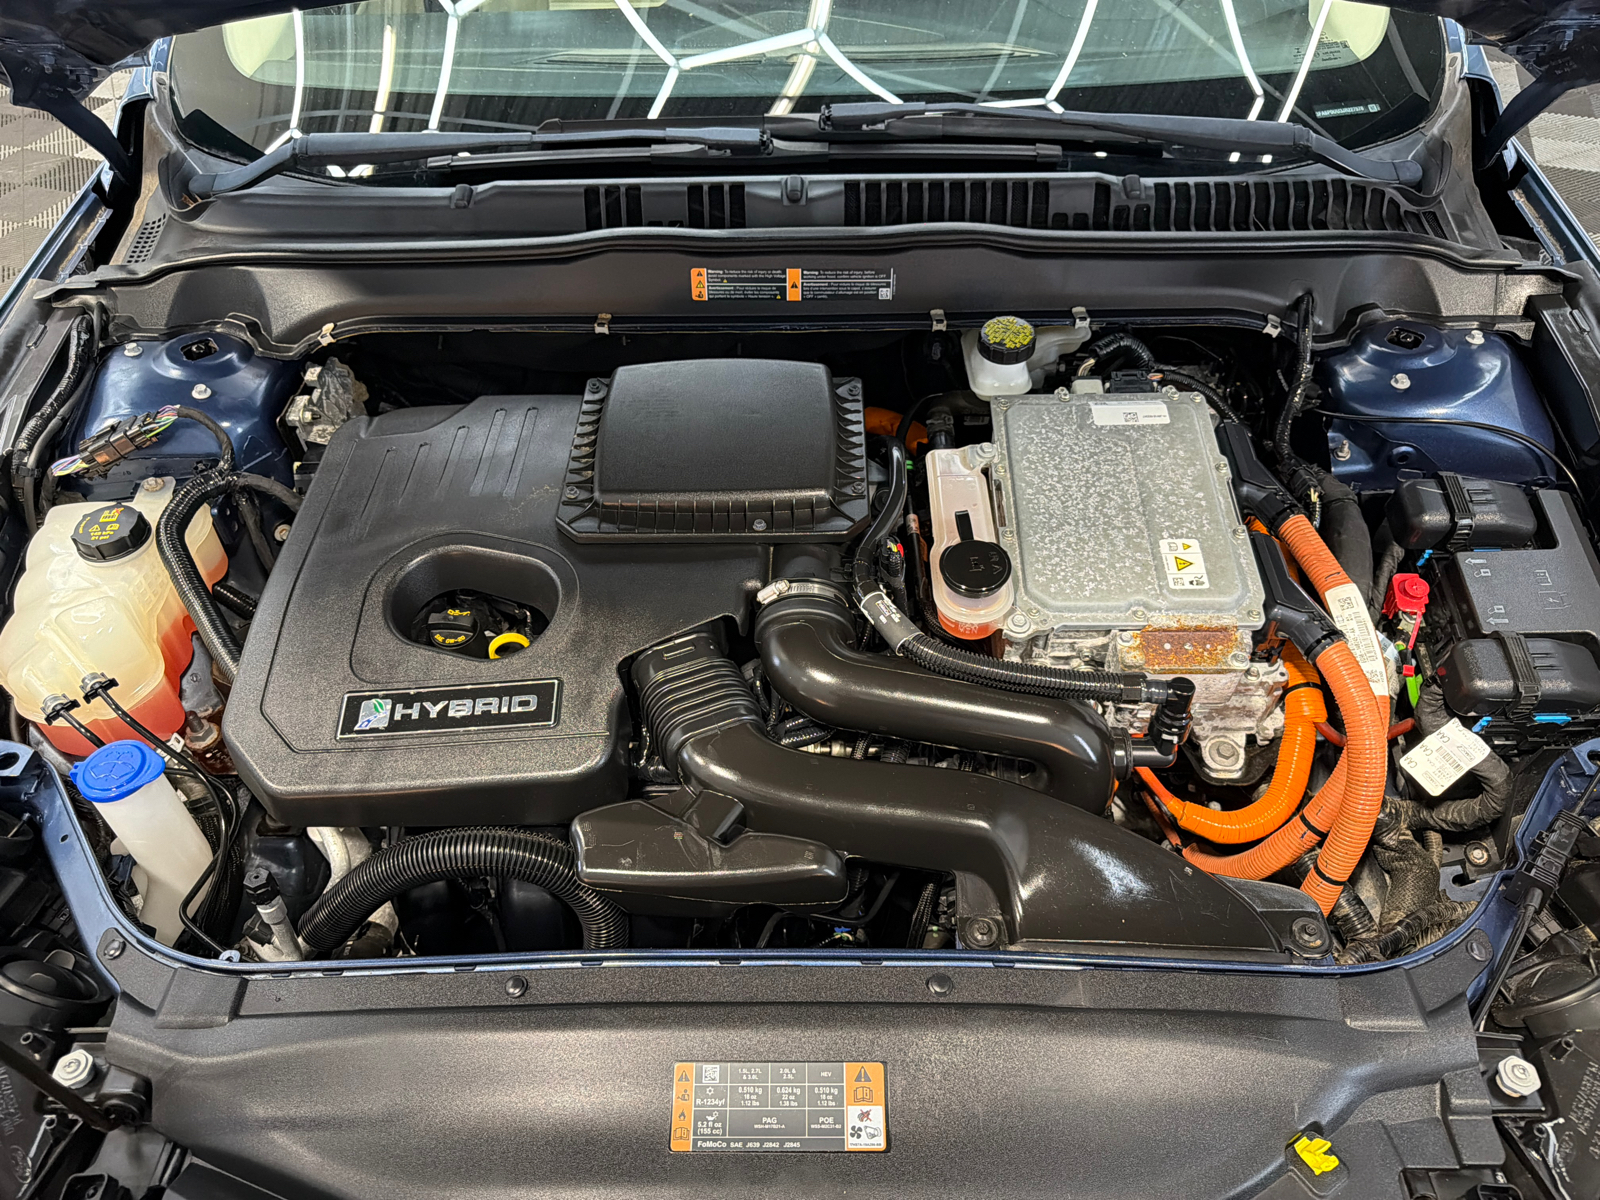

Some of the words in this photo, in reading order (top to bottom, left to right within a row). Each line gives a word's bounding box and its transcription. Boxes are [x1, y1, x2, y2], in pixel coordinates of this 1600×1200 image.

[434, 633, 445, 643] SAE
[394, 694, 538, 720] HYBRID
[1437, 730, 1451, 744] CAA
[1420, 742, 1434, 757] CAA
[1404, 755, 1418, 769] CAA
[738, 1086, 755, 1094] 0.510
[755, 1086, 763, 1095] kg
[776, 1086, 792, 1094] 0.624
[793, 1086, 801, 1095] kg
[814, 1086, 830, 1094] 0.510
[830, 1086, 839, 1095] kg
[696, 1098, 726, 1107] R-1234yf
[762, 1116, 778, 1124] PAG
[818, 1116, 835, 1124] POE
[697, 1121, 709, 1129] 5.2
[709, 1121, 714, 1129] fl
[697, 1128, 712, 1136] (155
[712, 1128, 723, 1136] cc)
[697, 1140, 728, 1149] FoMoCo
[730, 1141, 743, 1149] SAE
[746, 1141, 761, 1149] J639
[762, 1141, 780, 1149] J2842
[783, 1141, 801, 1149] J2845
